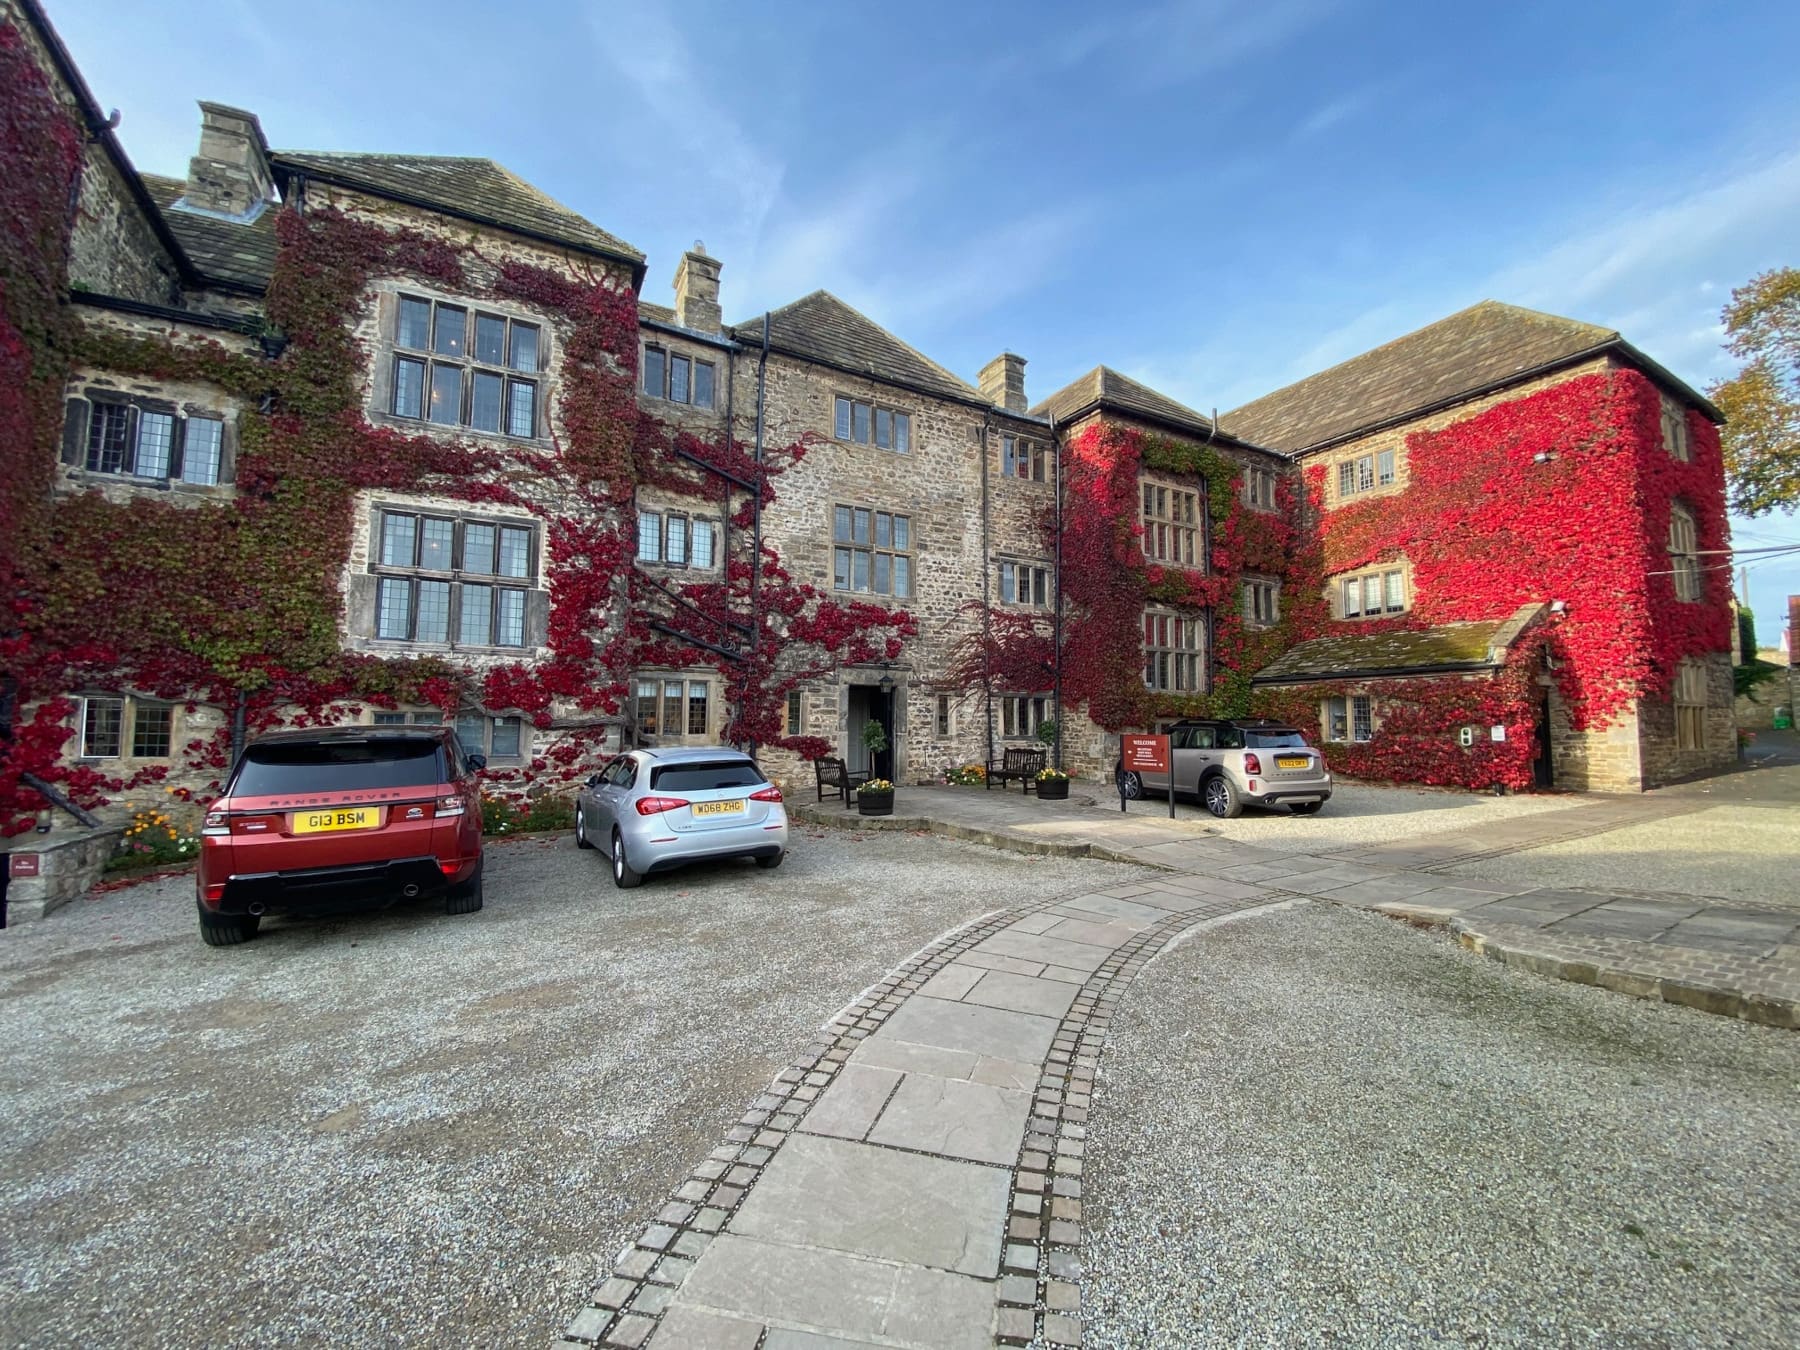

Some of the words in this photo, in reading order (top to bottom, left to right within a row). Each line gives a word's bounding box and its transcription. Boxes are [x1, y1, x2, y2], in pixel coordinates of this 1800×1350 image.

[270, 797, 330, 806] RANGE
[342, 792, 400, 801] ROVER
[723, 801, 740, 811] ZHG
[309, 815, 332, 827] G13
[337, 812, 365, 825] BSM
